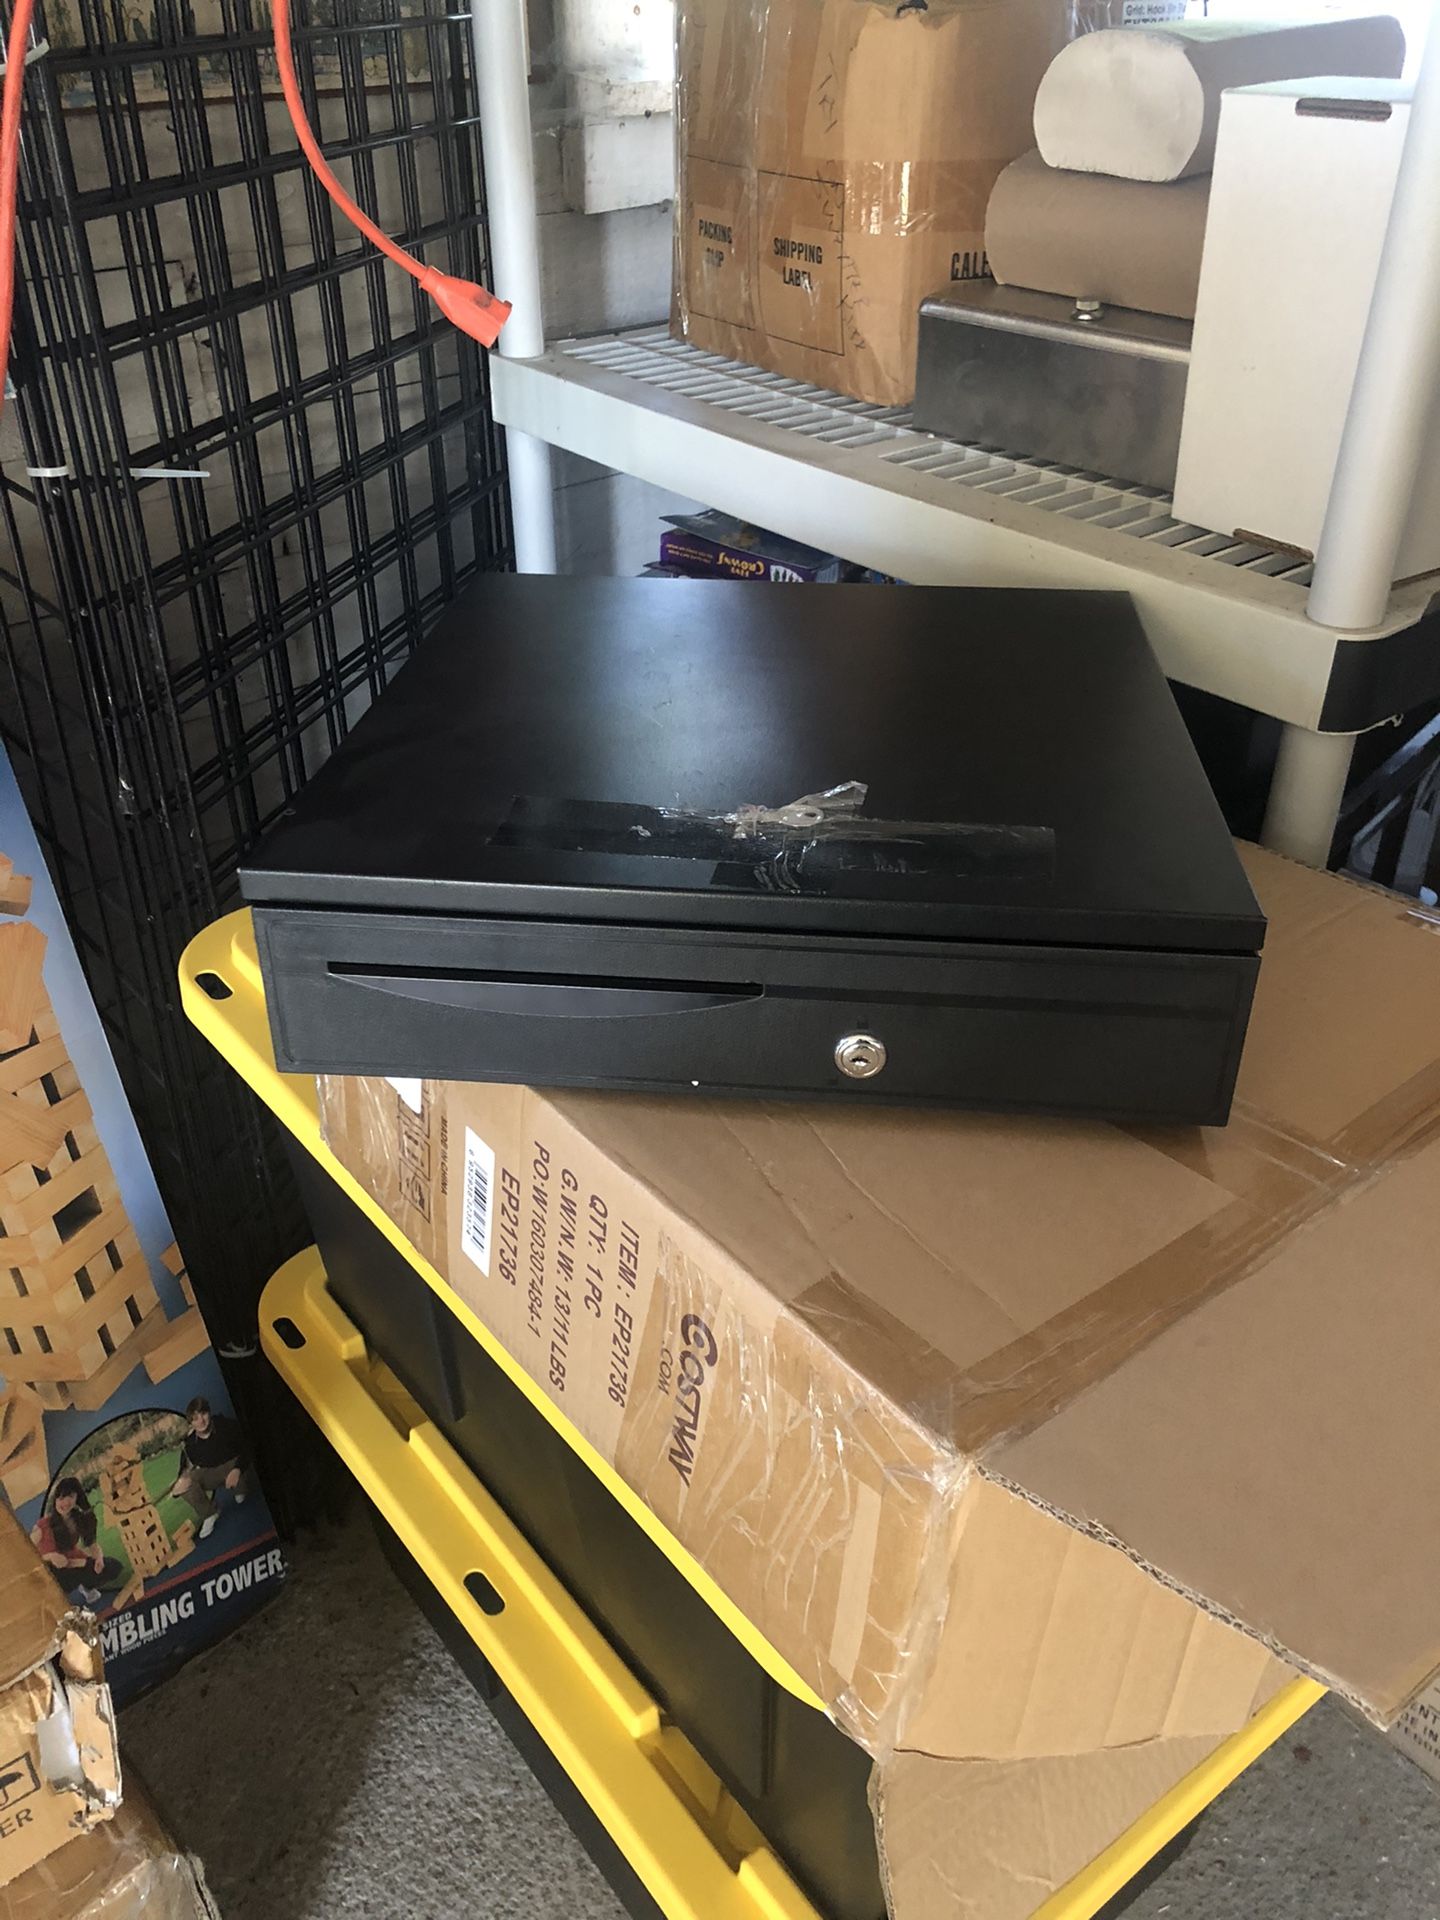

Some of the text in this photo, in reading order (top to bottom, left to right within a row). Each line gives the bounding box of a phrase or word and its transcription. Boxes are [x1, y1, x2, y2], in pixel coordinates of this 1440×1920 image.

[699, 219, 733, 244] PACKING
[773, 237, 823, 264] SHIPPING
[783, 266, 813, 291] LABEL
[440, 1115, 448, 1149] MADE
[441, 1161, 449, 1196] CHINA
[499, 1168, 520, 1286] EP21736
[588, 1194, 608, 1255] QTY:
[608, 1303, 633, 1408] EP21736
[668, 1313, 718, 1488] COSTWAY
[200, 1549, 283, 1607] TOWER
